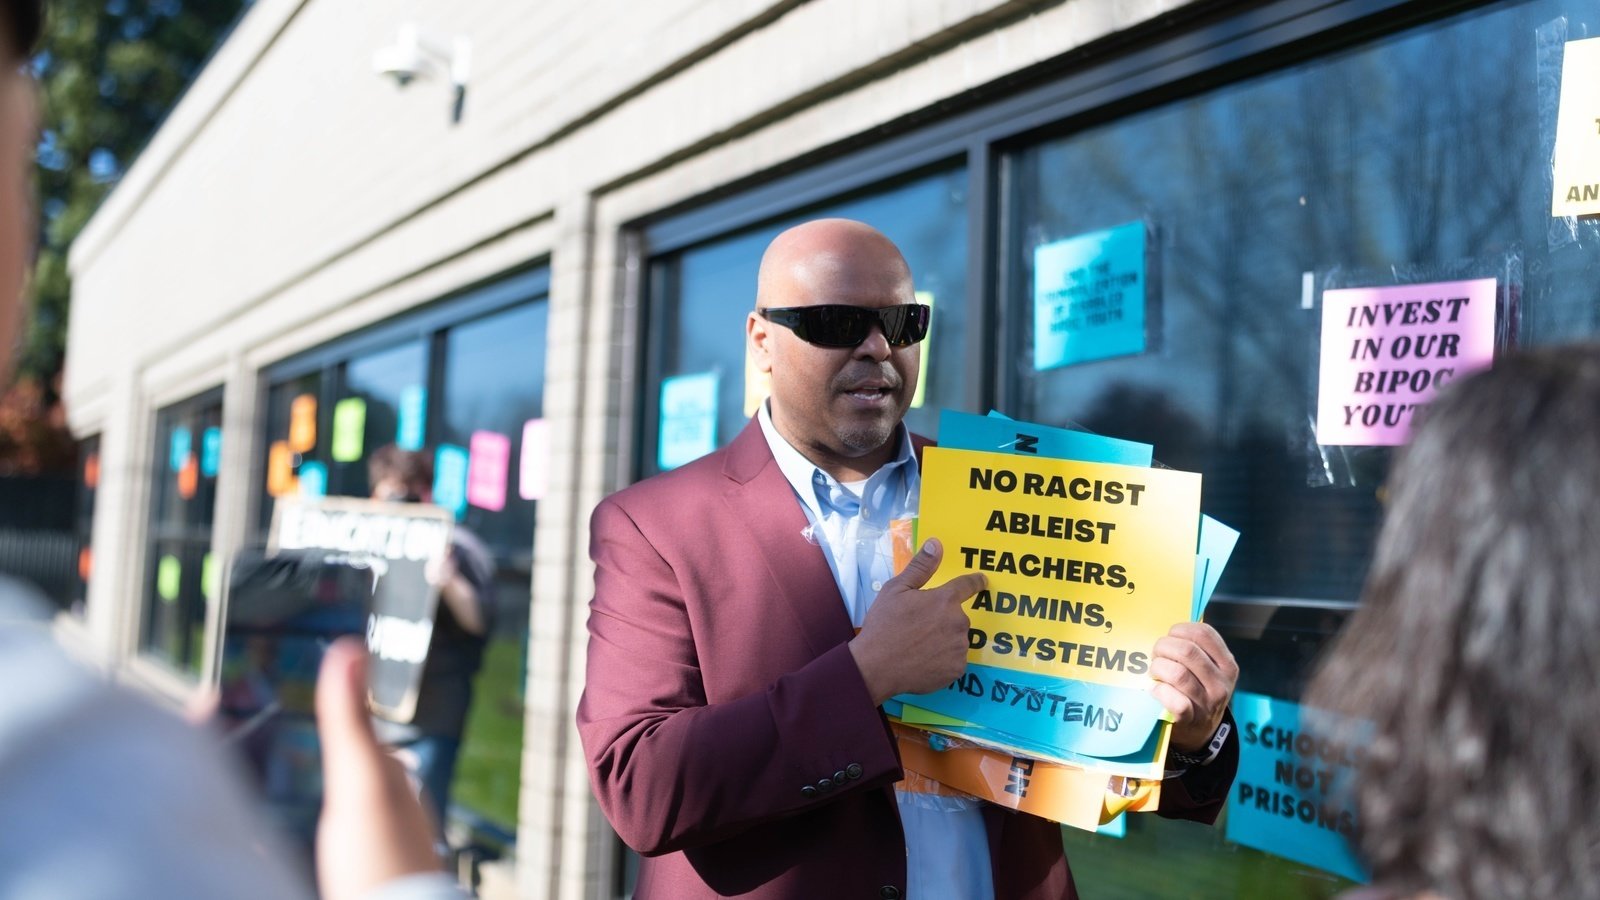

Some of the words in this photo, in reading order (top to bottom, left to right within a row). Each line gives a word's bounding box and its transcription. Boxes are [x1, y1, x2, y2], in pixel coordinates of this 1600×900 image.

[1346, 297, 1470, 328] INVEST
[1350, 337, 1383, 361] IN
[1390, 333, 1461, 360] OUR
[1353, 367, 1455, 394] BIPOC
[968, 467, 1018, 493] NO
[1022, 472, 1146, 506] RACIST
[984, 510, 1116, 545] ABLEIST
[960, 546, 1136, 595] TEACHERS,
[970, 590, 1113, 634] ADMINS,
[991, 630, 1149, 675] SYSTEMS
[948, 672, 985, 698] ND
[990, 680, 1124, 733] SYSTEMS
[1274, 760, 1334, 796] NOT
[1238, 783, 1353, 835] PRISONS
